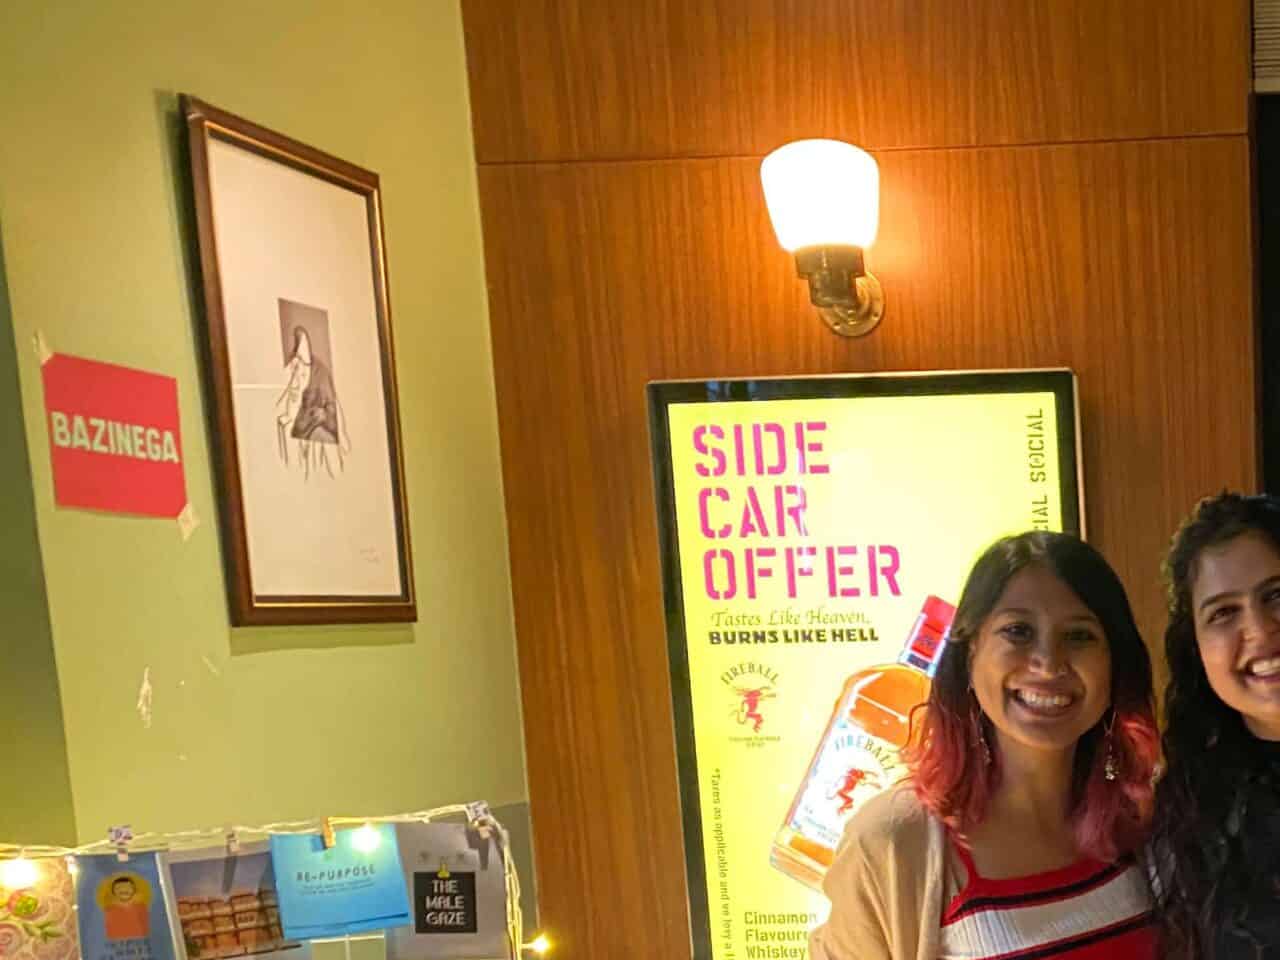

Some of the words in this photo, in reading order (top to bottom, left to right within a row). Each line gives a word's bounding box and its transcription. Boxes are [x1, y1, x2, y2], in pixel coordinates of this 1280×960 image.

[50, 411, 181, 464] BAZINEGA
[1025, 408, 1046, 483] SOCIAL
[693, 421, 830, 477] SIDE
[698, 485, 808, 539] CAR
[703, 545, 902, 600] OFFER
[710, 608, 761, 627] Tastes
[767, 607, 801, 625] Like
[709, 631, 779, 645] BURNS
[783, 629, 827, 643] LIKE
[831, 628, 879, 643] HELL
[720, 662, 779, 686] FIREBALL
[431, 880, 458, 893] THE
[426, 895, 465, 910] MALE
[426, 912, 466, 925] GAZE
[744, 911, 818, 925] Cinnamon
[745, 929, 808, 942] Flavour
[746, 945, 807, 960] Whiskey
